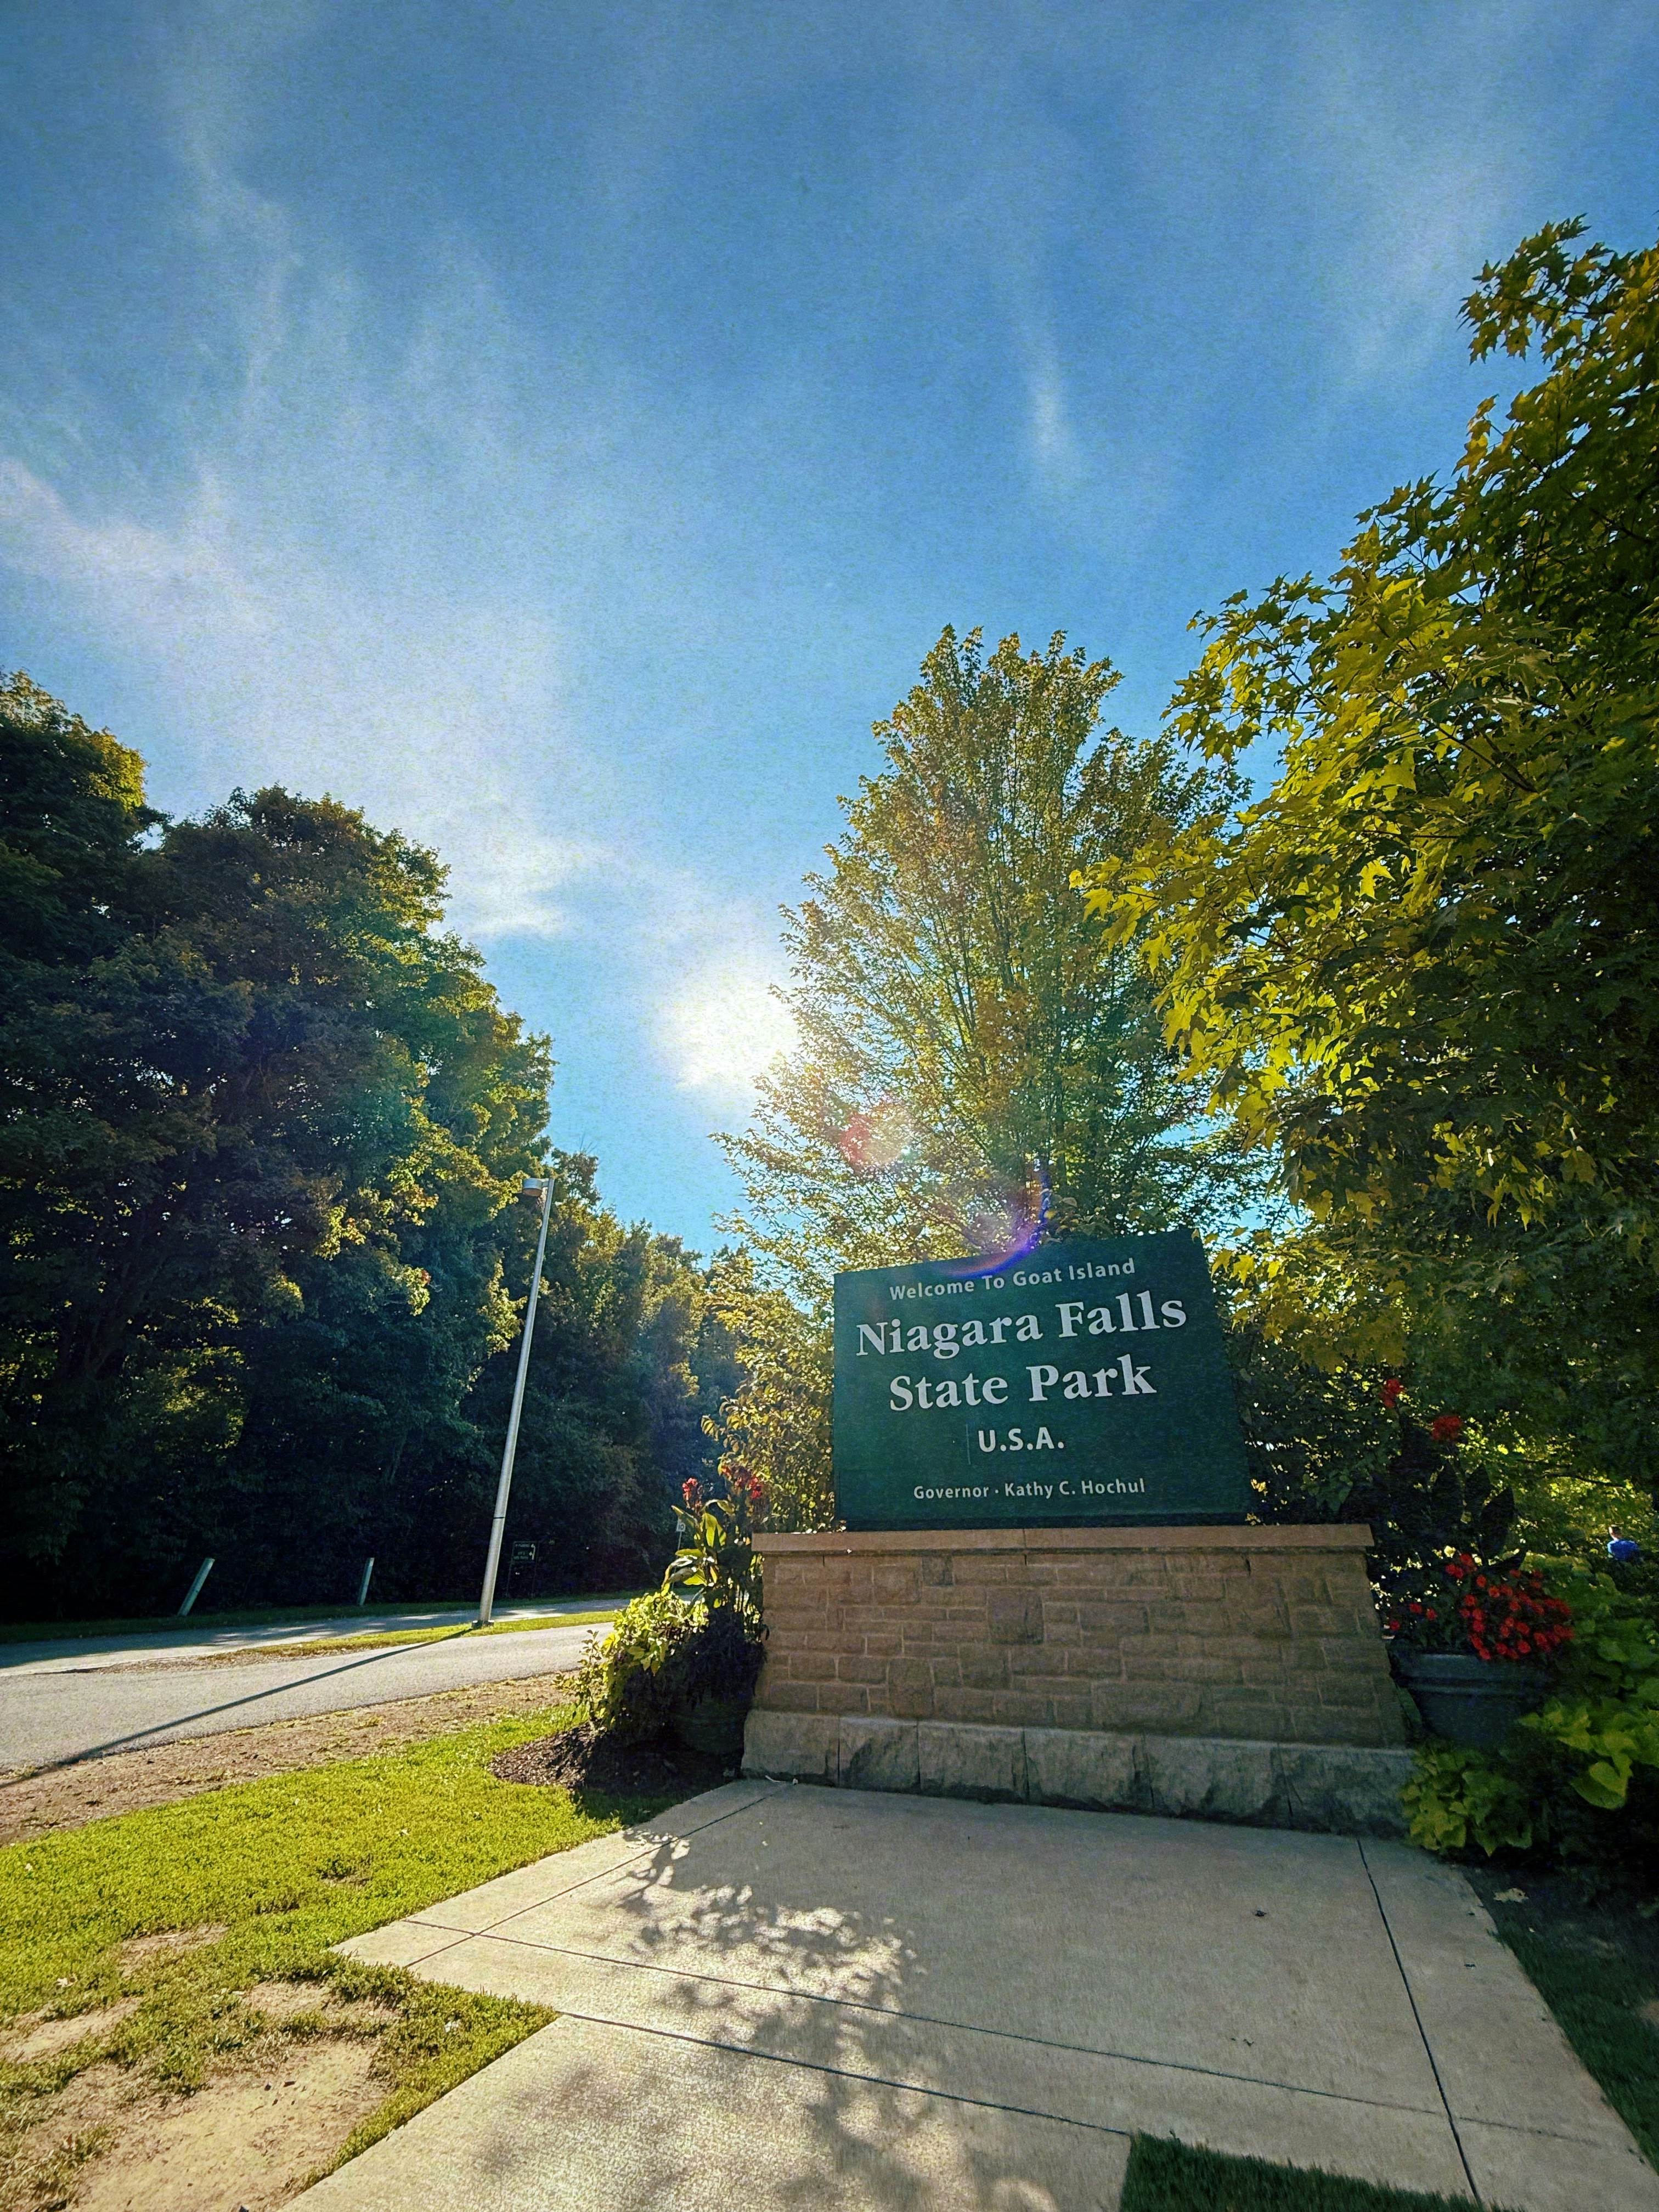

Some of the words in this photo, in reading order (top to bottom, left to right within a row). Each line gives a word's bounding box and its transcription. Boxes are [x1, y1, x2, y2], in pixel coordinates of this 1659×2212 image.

[890, 1280, 974, 1301] Welcome
[981, 1274, 1005, 1290] To
[1013, 1267, 1062, 1287] Goat
[1069, 1258, 1135, 1280] Island
[855, 1314, 1043, 1359] Niagara
[1054, 1290, 1187, 1338] Falls
[889, 1373, 1008, 1412] State
[1026, 1354, 1157, 1402] Park
[978, 1426, 1065, 1453] U.S.A.
[913, 1485, 990, 1499] Governor
[1005, 1481, 1053, 1499] Kathy
[1059, 1481, 1076, 1496] C.
[1081, 1478, 1146, 1495] Hochul
